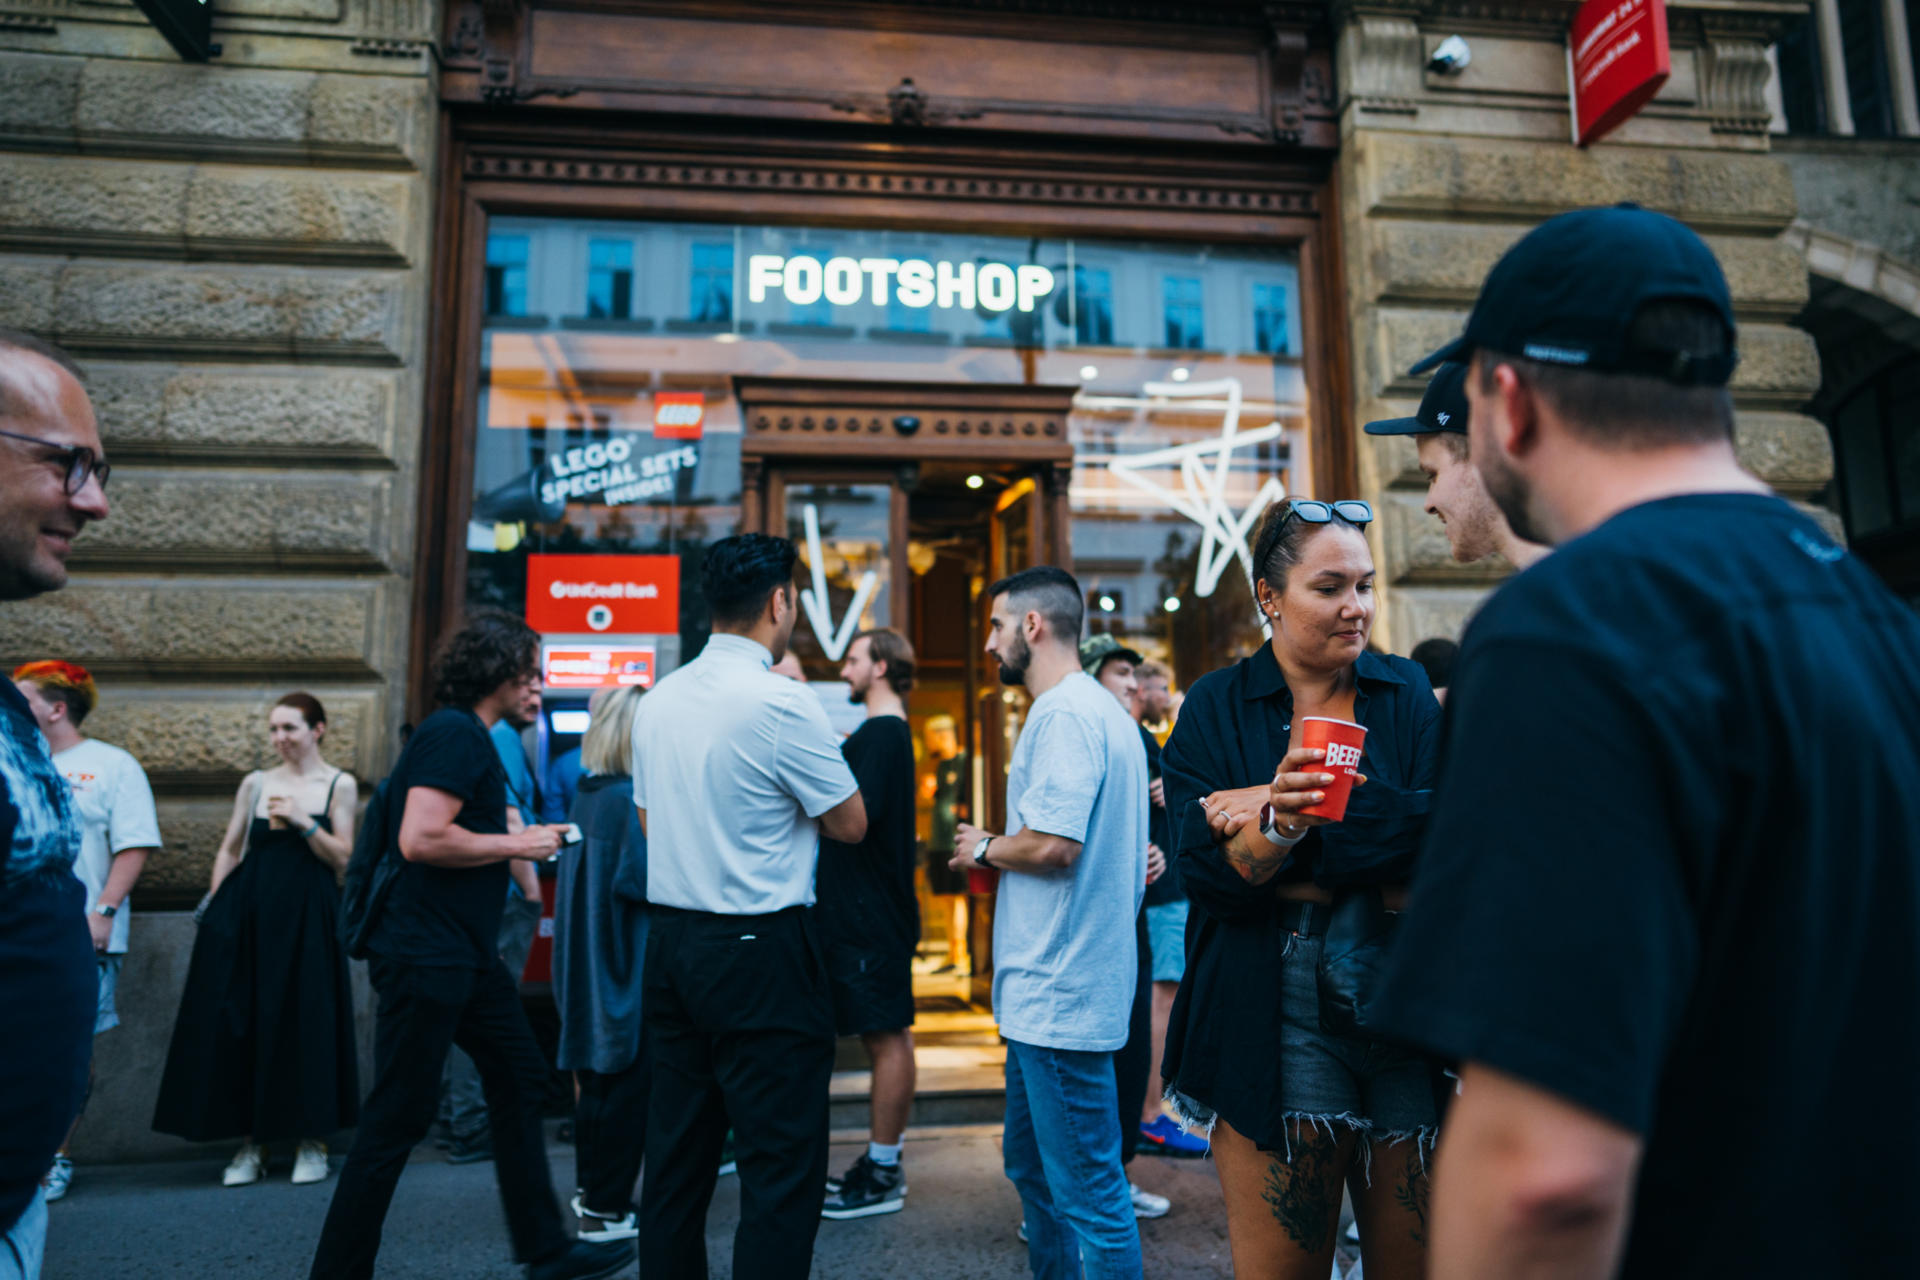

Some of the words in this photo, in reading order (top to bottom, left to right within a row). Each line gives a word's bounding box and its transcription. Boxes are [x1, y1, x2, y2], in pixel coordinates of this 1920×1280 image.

[748, 254, 1055, 312] FOOTSHOP
[656, 404, 702, 425] LEGO
[541, 463, 638, 504] SPECIAL
[640, 446, 697, 478] SETS
[551, 437, 631, 477] LEGO
